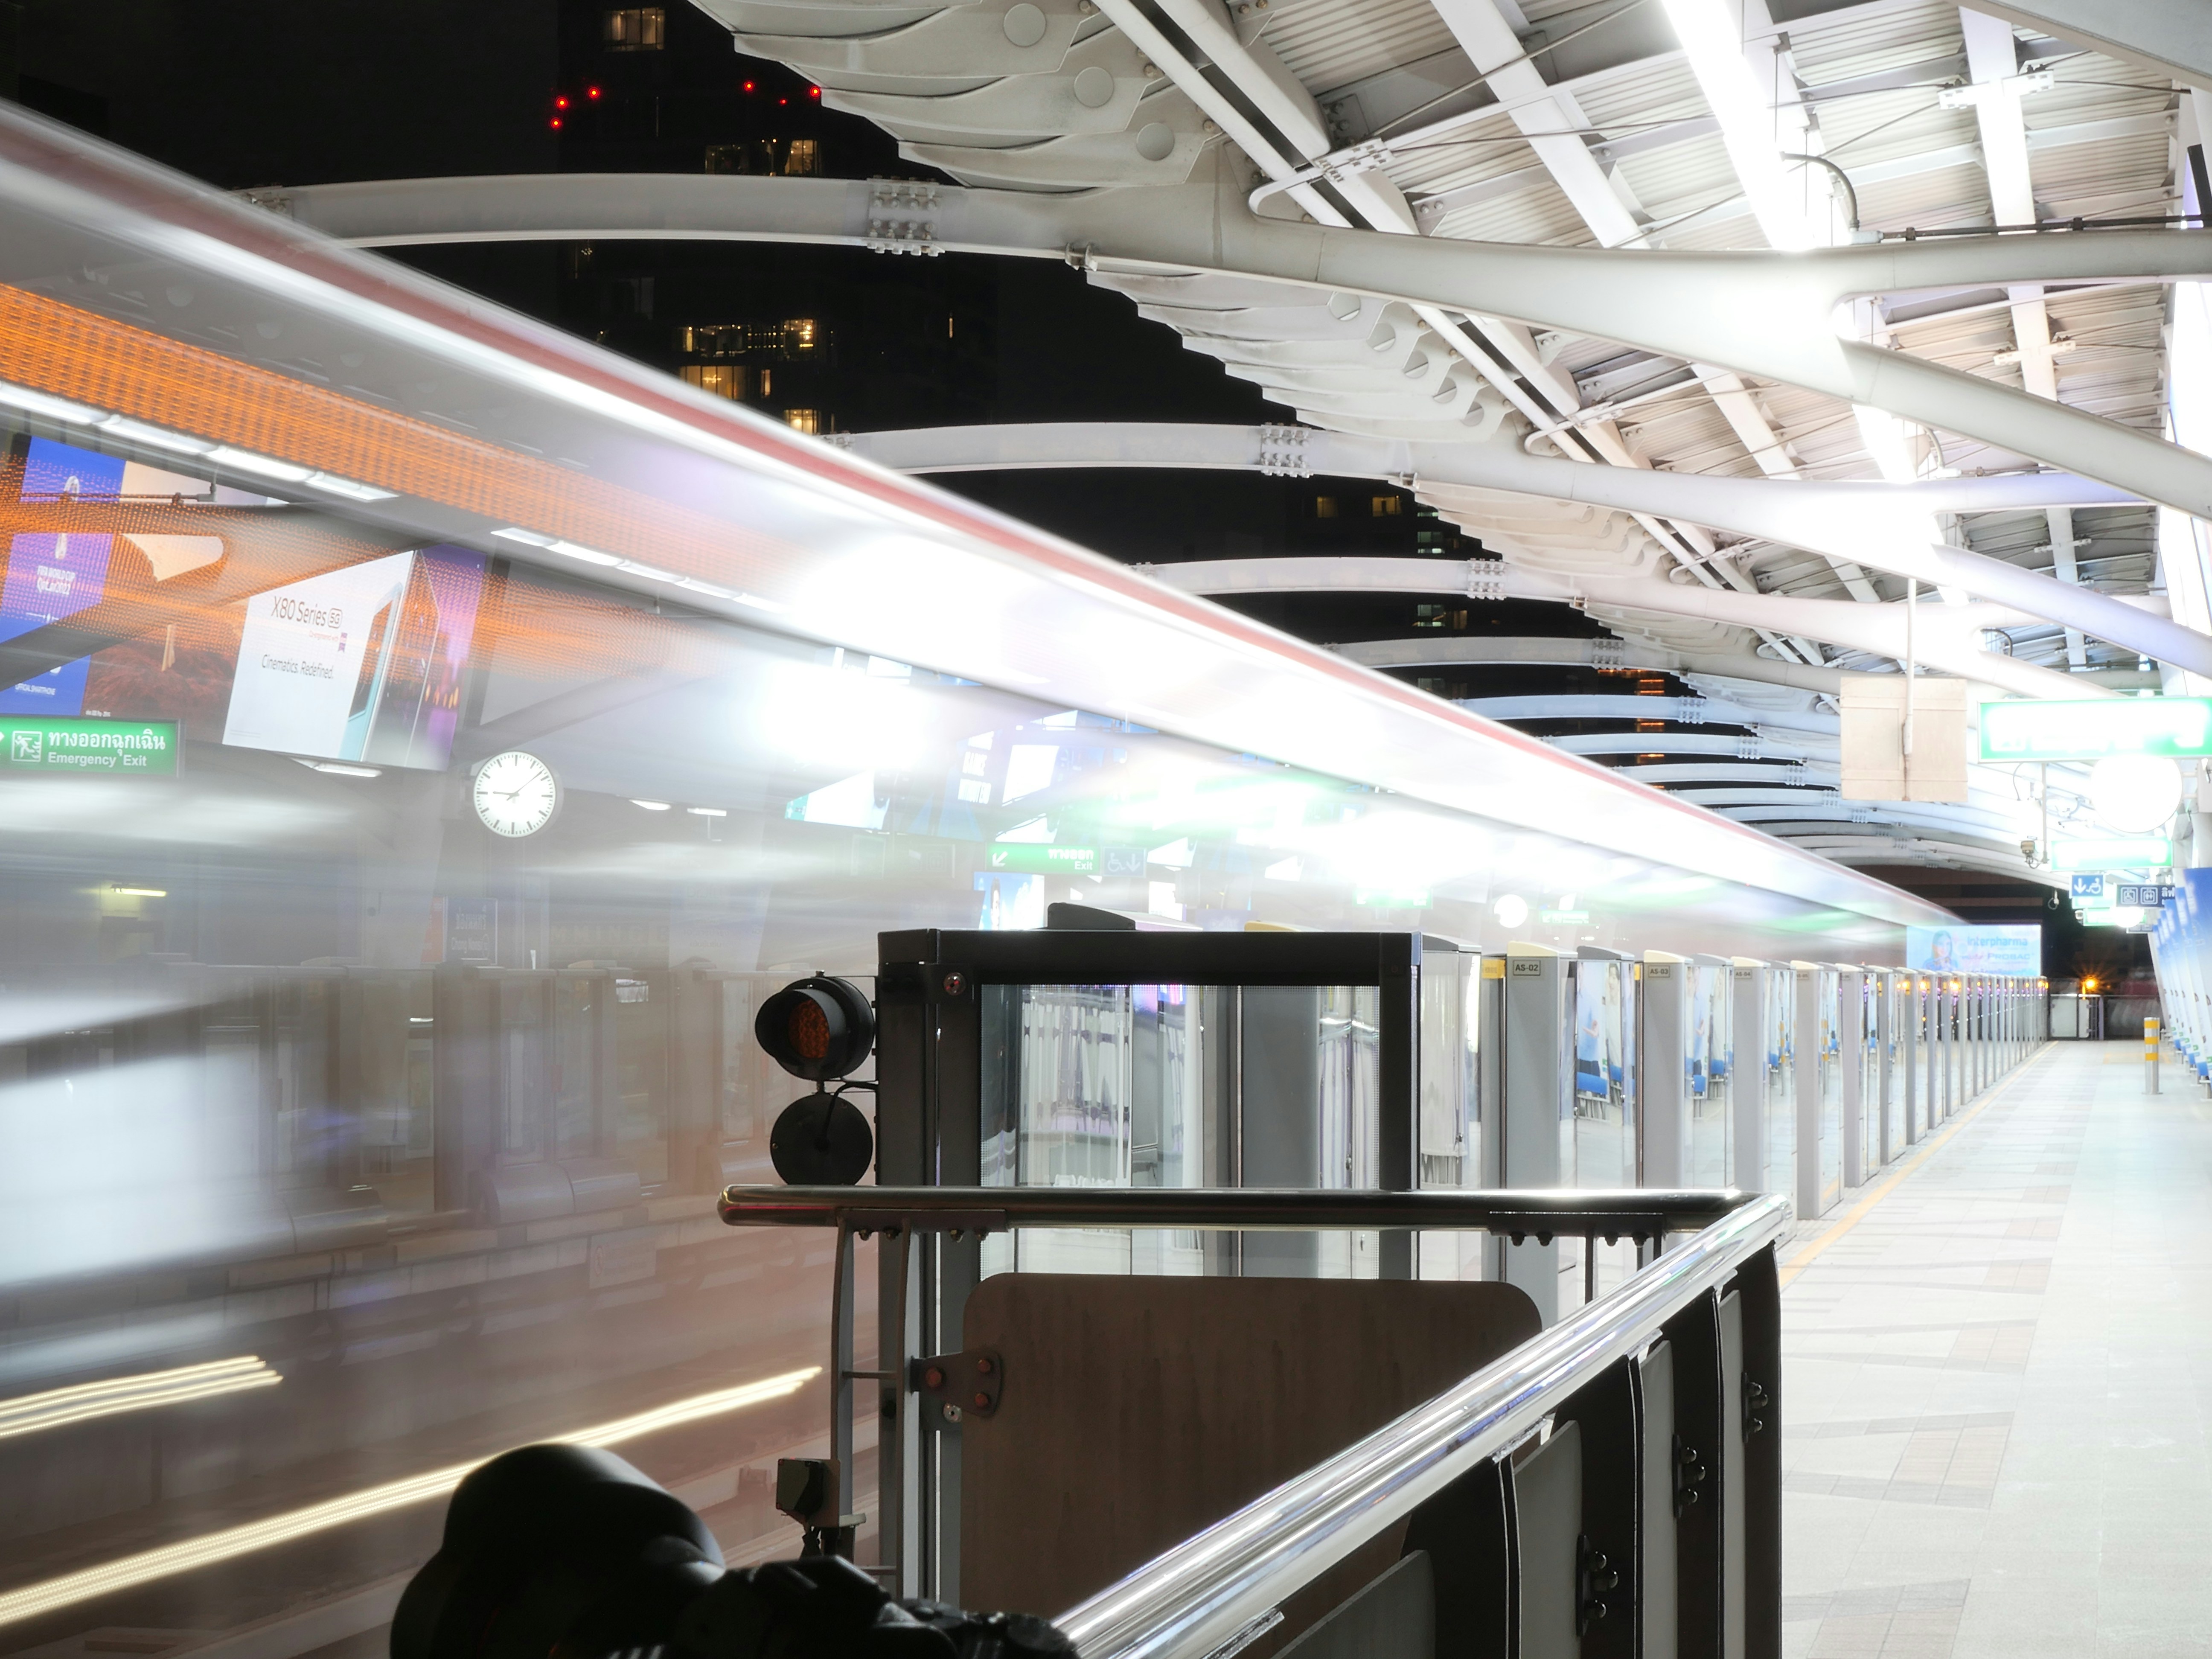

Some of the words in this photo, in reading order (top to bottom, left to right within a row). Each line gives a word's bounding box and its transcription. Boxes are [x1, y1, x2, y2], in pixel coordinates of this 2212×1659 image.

[271, 596, 296, 620] X80
[297, 601, 327, 626] Series
[329, 612, 340, 624] 5G
[48, 728, 166, 757] ทางออกฉุกเฉิน
[48, 751, 116, 768] Emergency
[123, 754, 147, 766] Exit
[1074, 861, 1093, 870] Exit
